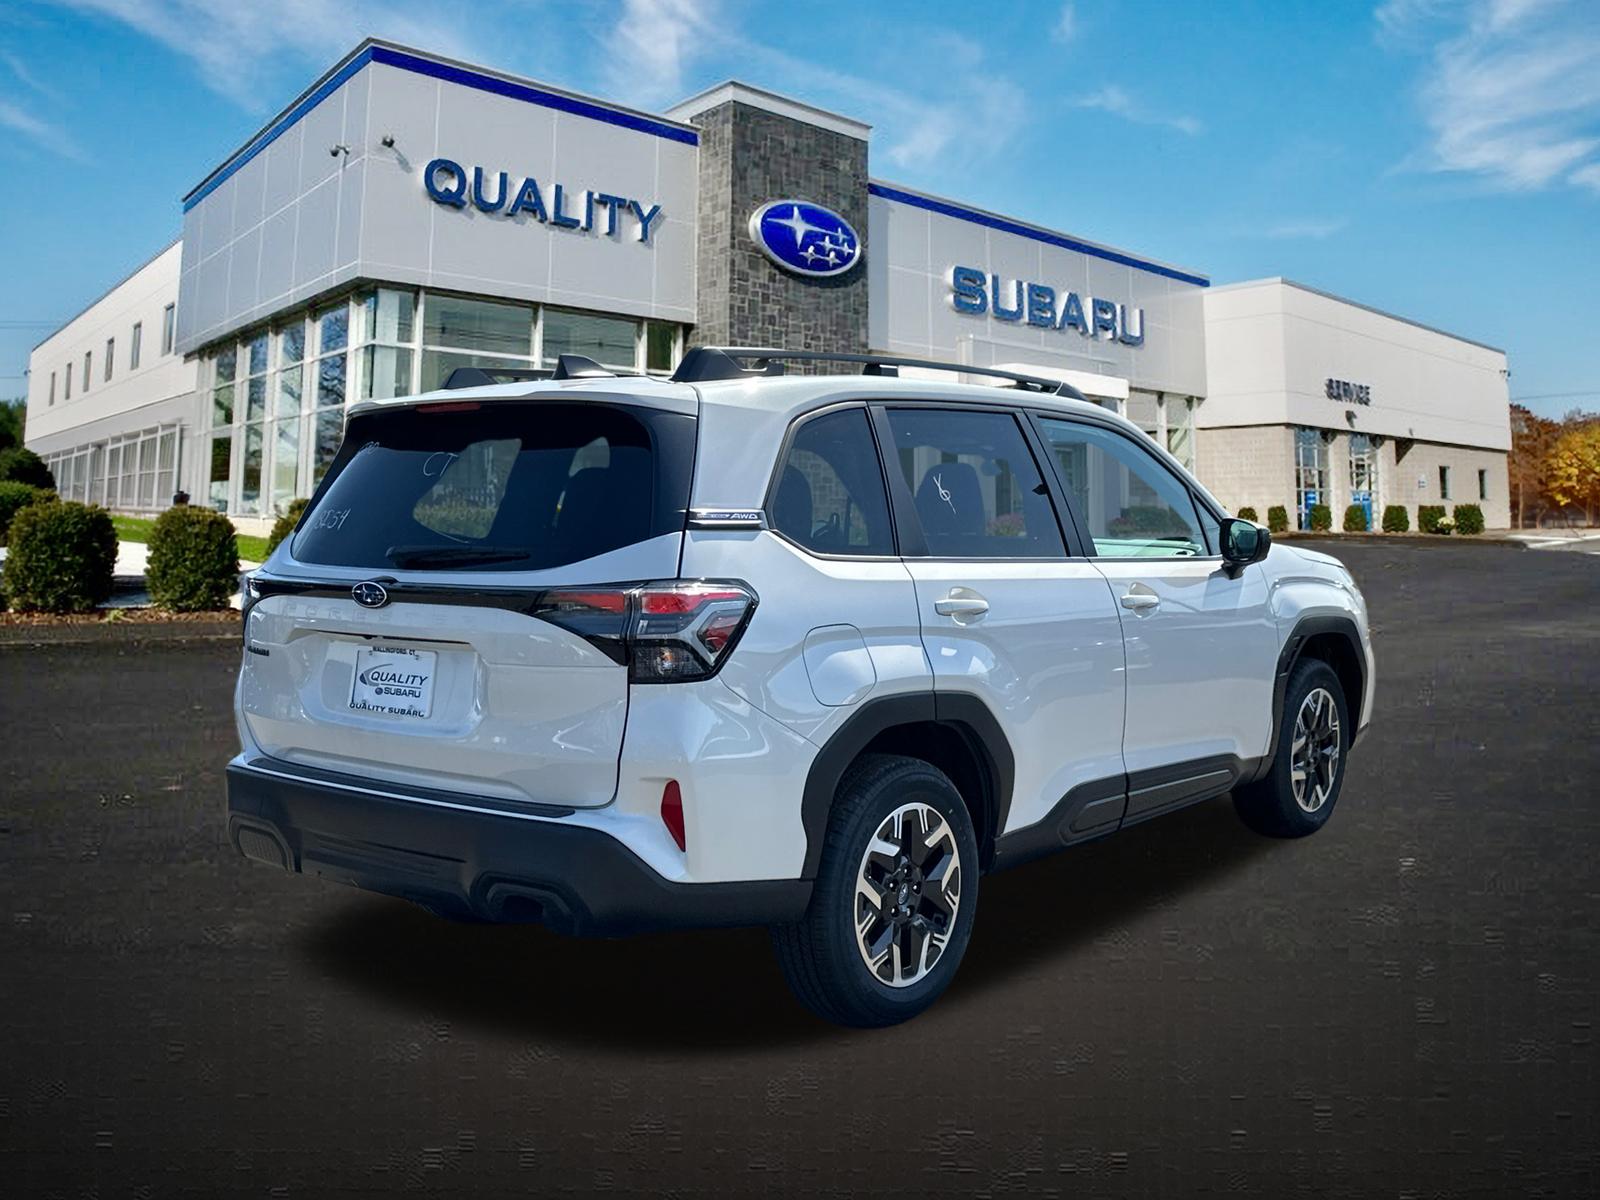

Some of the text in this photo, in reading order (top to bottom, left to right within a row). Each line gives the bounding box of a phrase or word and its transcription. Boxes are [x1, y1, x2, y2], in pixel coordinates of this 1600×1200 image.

[423, 157, 663, 243] QUALITY
[949, 265, 1145, 346] SUBARU
[729, 512, 759, 520] AWD
[371, 671, 428, 686] QUALITY
[383, 687, 421, 698] SUBARU
[349, 702, 425, 718] QUALITY SUBARU
